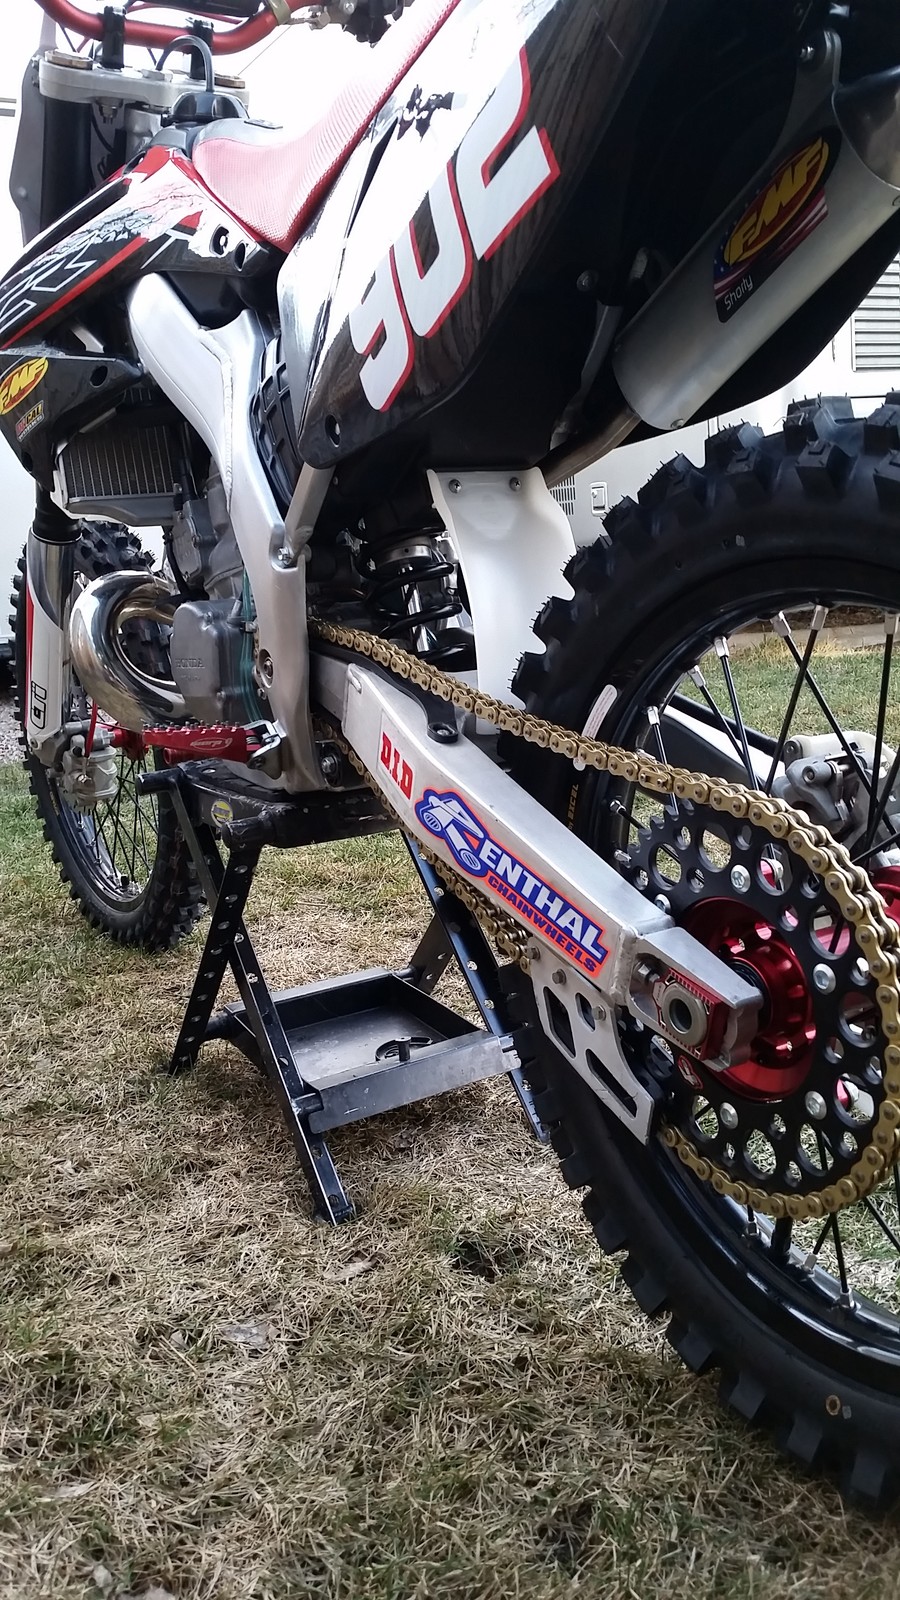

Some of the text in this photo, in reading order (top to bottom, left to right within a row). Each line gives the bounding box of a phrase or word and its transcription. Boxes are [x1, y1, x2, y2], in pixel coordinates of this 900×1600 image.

[728, 136, 824, 266] FMF
[723, 274, 754, 311] Shorty
[566, 783, 580, 821] EXCEL
[487, 874, 598, 973] CHAINWHEELS
